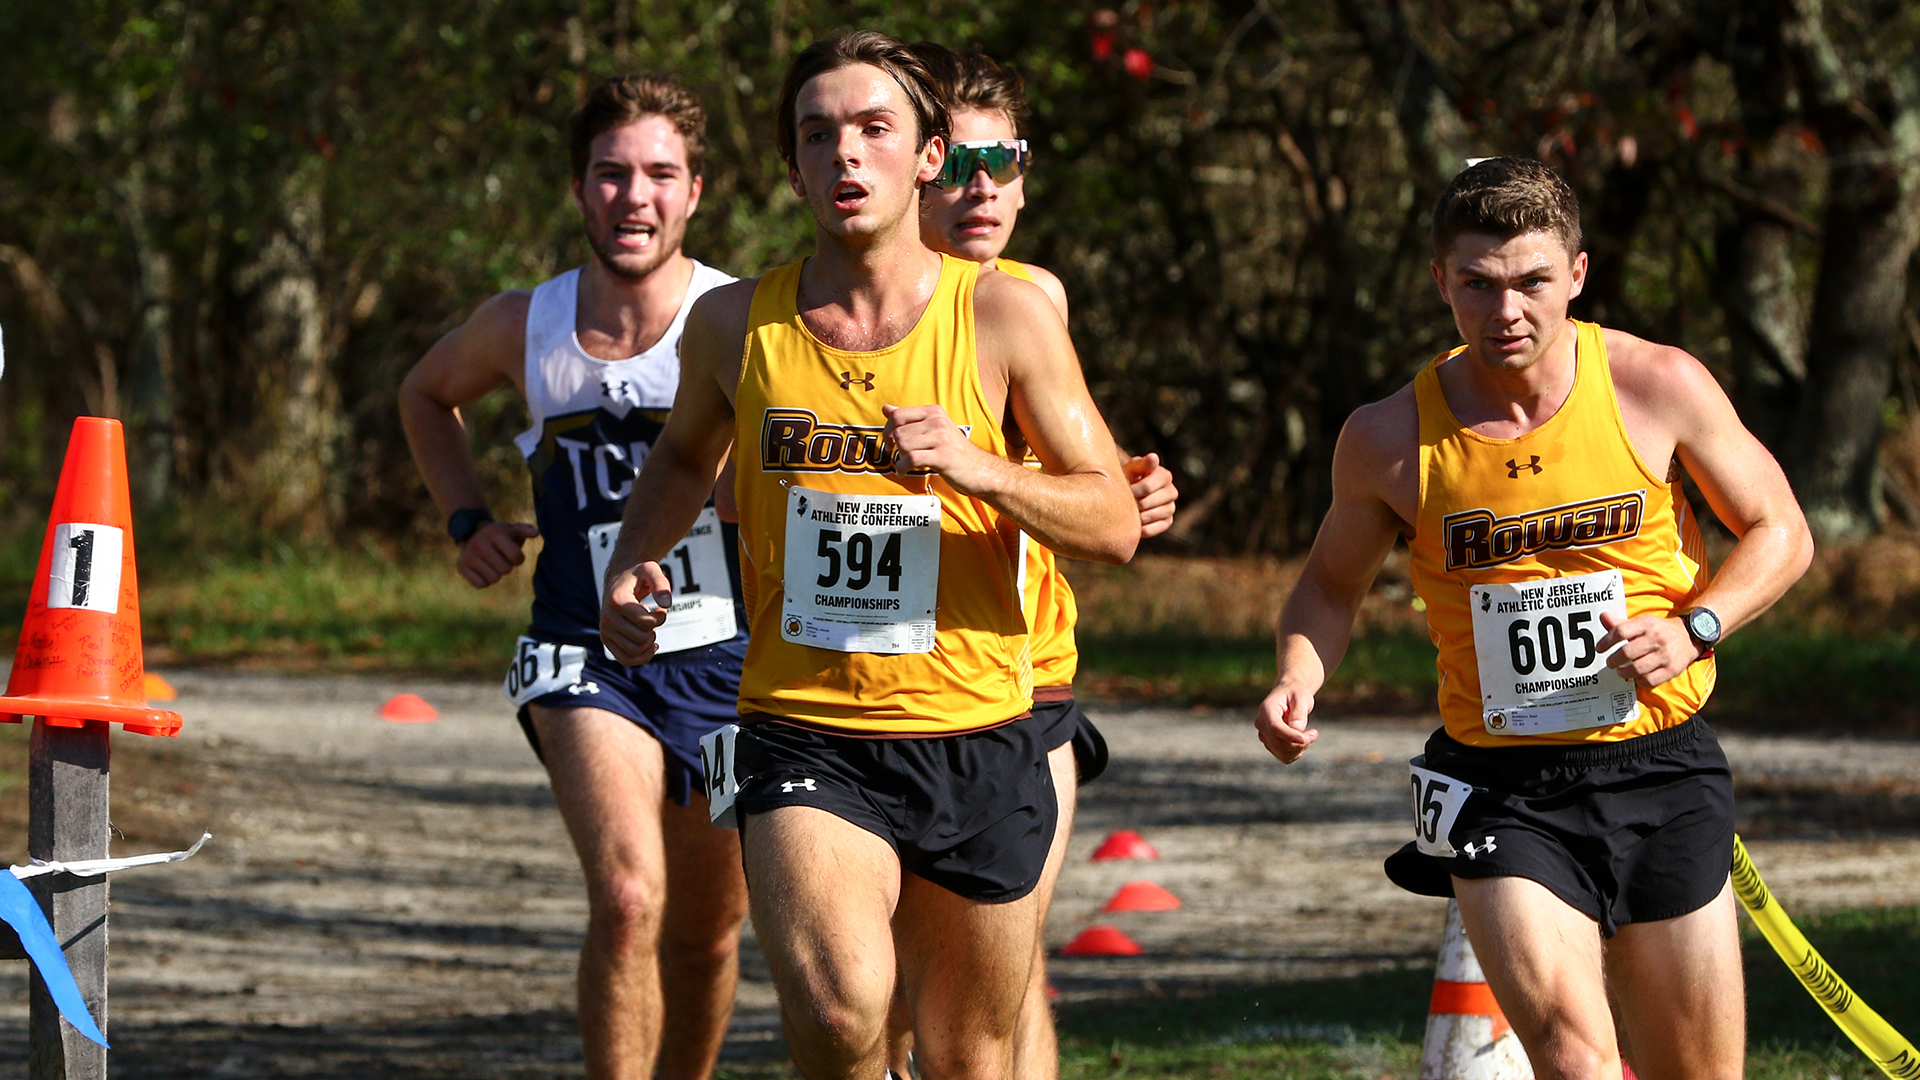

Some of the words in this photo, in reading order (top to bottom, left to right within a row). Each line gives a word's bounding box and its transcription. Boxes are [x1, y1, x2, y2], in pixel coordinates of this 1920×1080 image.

[761, 408, 902, 475] Row
[811, 509, 858, 525] ATHLETIC
[861, 514, 929, 527] CONFERENCE
[837, 501, 861, 513] NEW
[863, 503, 903, 515] JERSEY
[71, 529, 94, 607] 1
[816, 528, 903, 592] 594
[815, 594, 900, 610] CHAMPIONSHIPS
[1497, 599, 1544, 614] ATHLETIC
[1546, 590, 1614, 609] CONFERENCE
[1521, 587, 1544, 601] NEW
[1547, 582, 1586, 597] JERSEY
[1508, 611, 1596, 675] 605
[1515, 674, 1599, 694] CHAMPIONSHIPS
